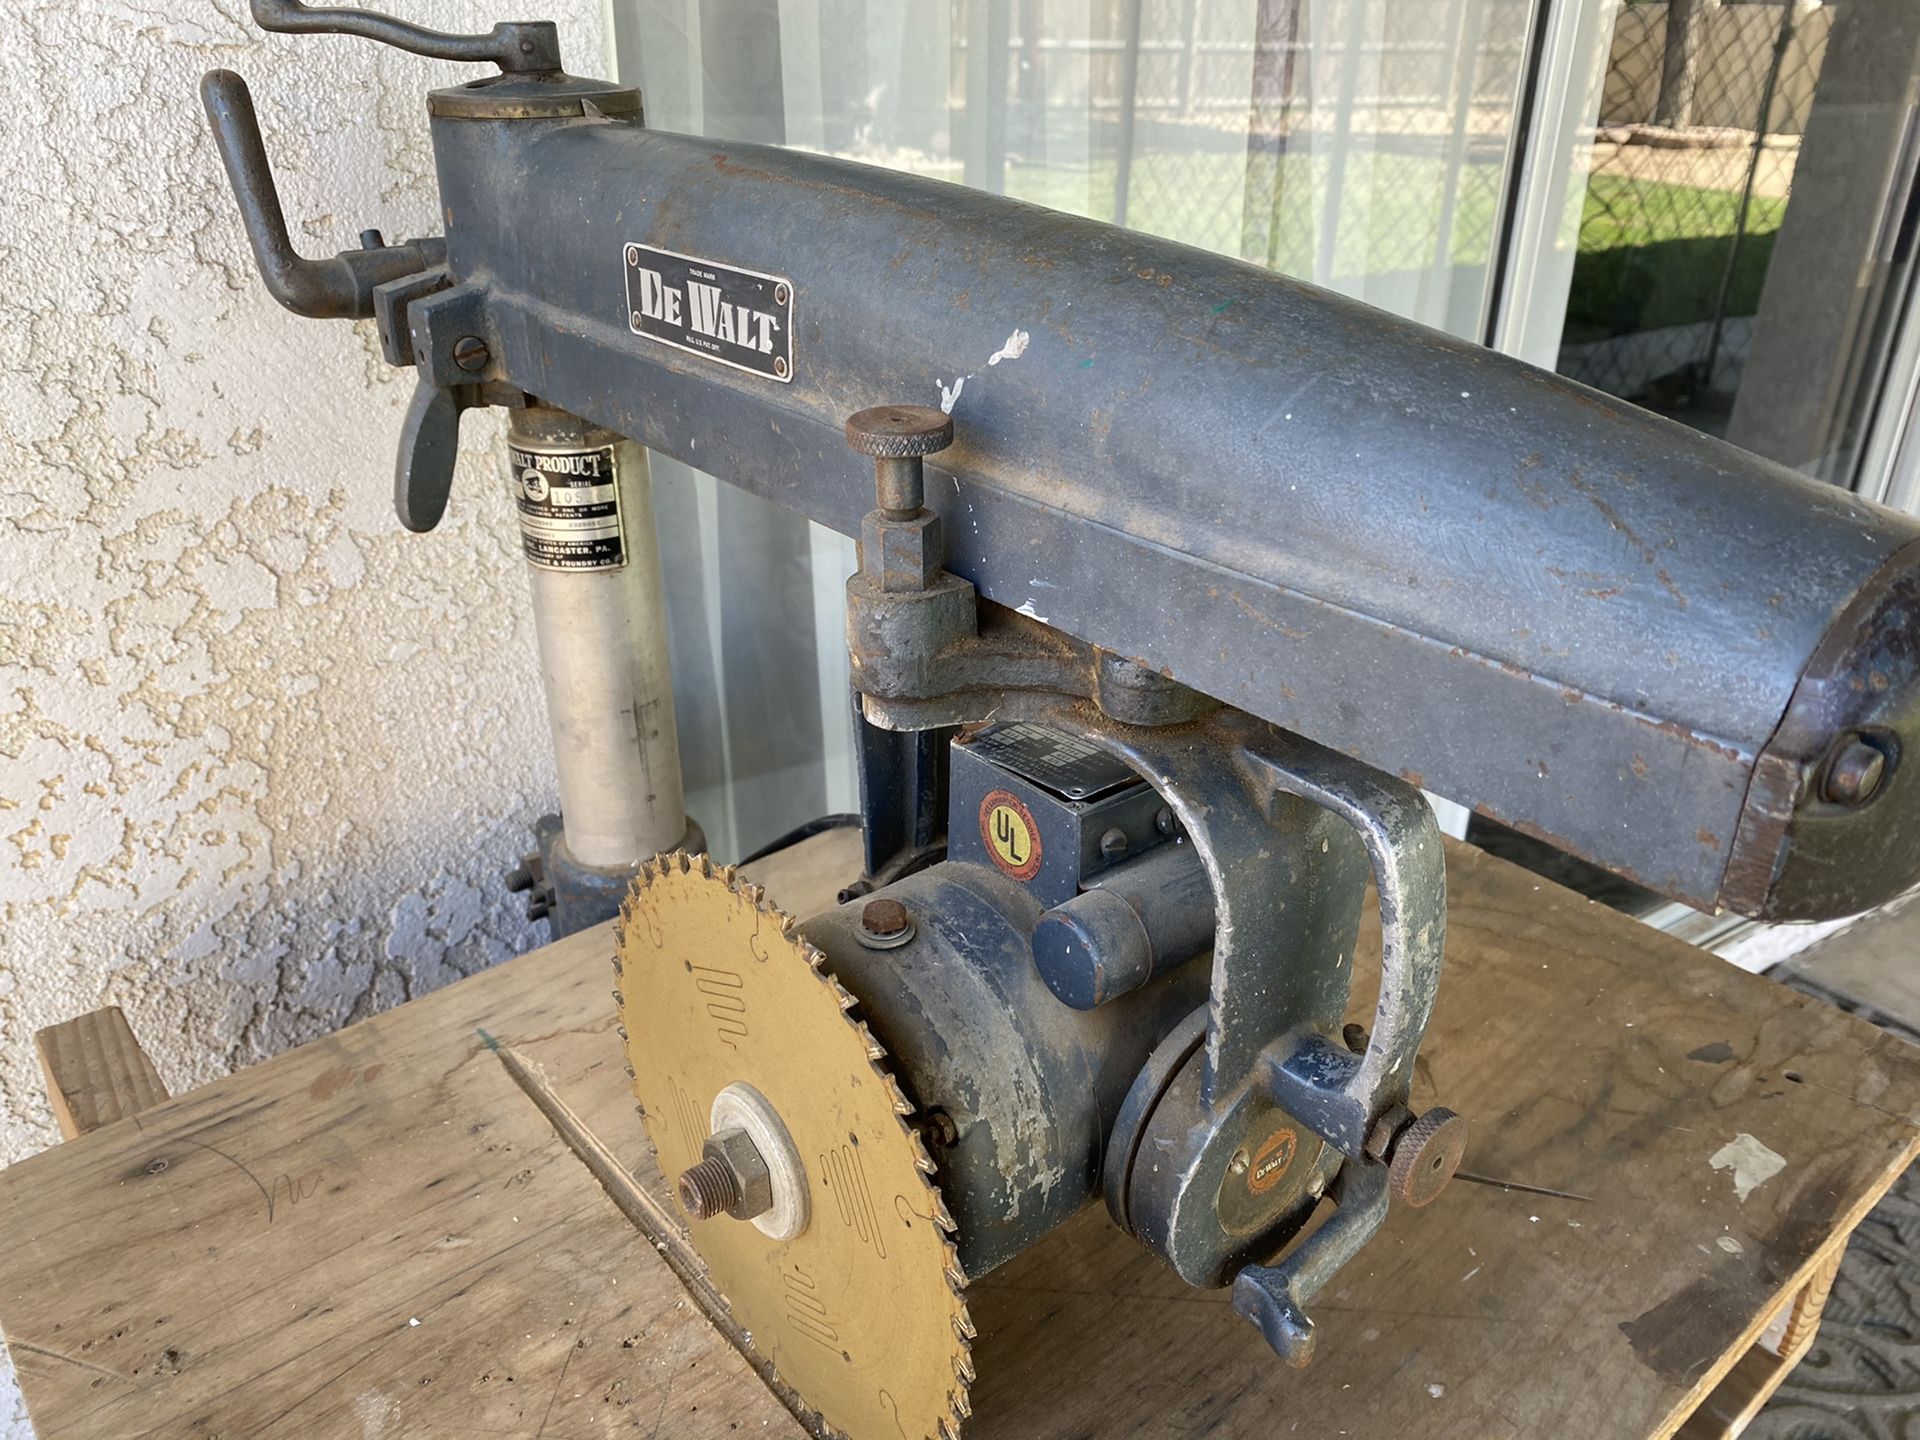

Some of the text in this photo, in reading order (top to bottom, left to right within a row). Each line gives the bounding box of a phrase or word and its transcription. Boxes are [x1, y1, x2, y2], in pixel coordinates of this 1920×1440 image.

[689, 267, 717, 281] TRADE MARK
[534, 454, 601, 477] PRODUCT
[595, 545, 611, 553] PA.
[997, 808, 1023, 863] UL
